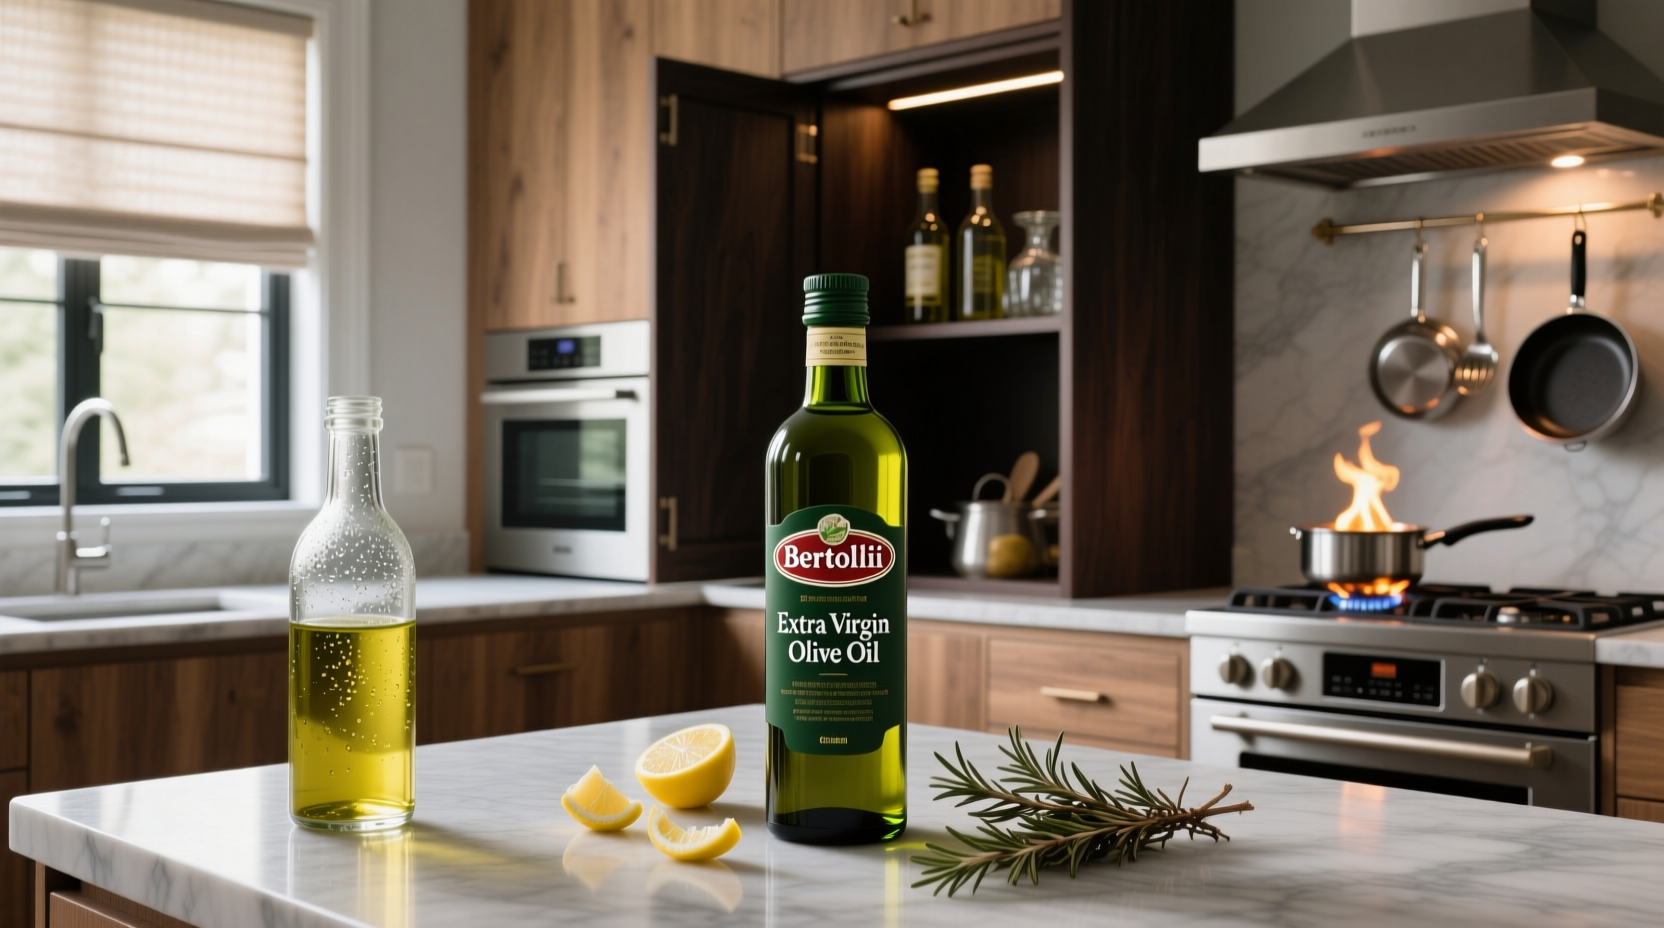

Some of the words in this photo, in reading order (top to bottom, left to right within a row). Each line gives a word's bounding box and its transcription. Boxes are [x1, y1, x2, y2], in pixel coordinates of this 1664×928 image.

[783, 544, 884, 569] Bertollii
[777, 611, 827, 635] Extra
[829, 612, 890, 641] Virgin
[788, 639, 842, 664] Olive
[846, 641, 880, 664] Oil
